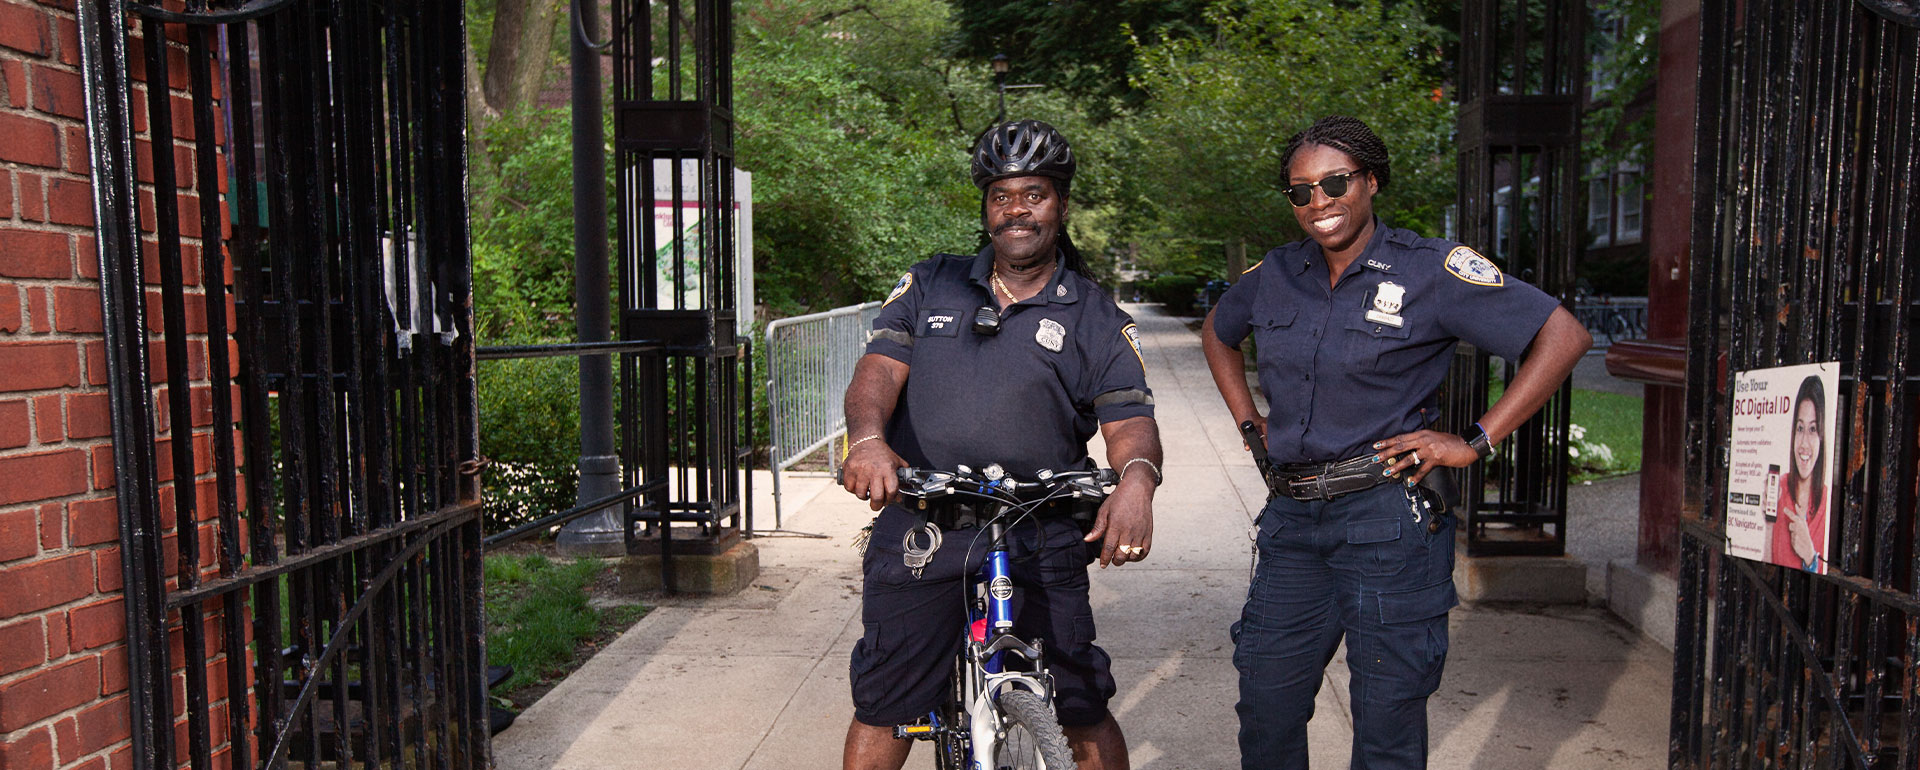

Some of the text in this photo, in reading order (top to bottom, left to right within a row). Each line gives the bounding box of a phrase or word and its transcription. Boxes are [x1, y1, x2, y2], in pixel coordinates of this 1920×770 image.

[1367, 259, 1391, 270] CUNY
[927, 315, 953, 323] SUTTON
[1736, 378, 1768, 393] Use Your
[1735, 396, 1790, 420] BC Digital ID
[1729, 507, 1749, 515] Download
[1728, 516, 1734, 527] BC
[1734, 517, 1757, 532] Navigator
